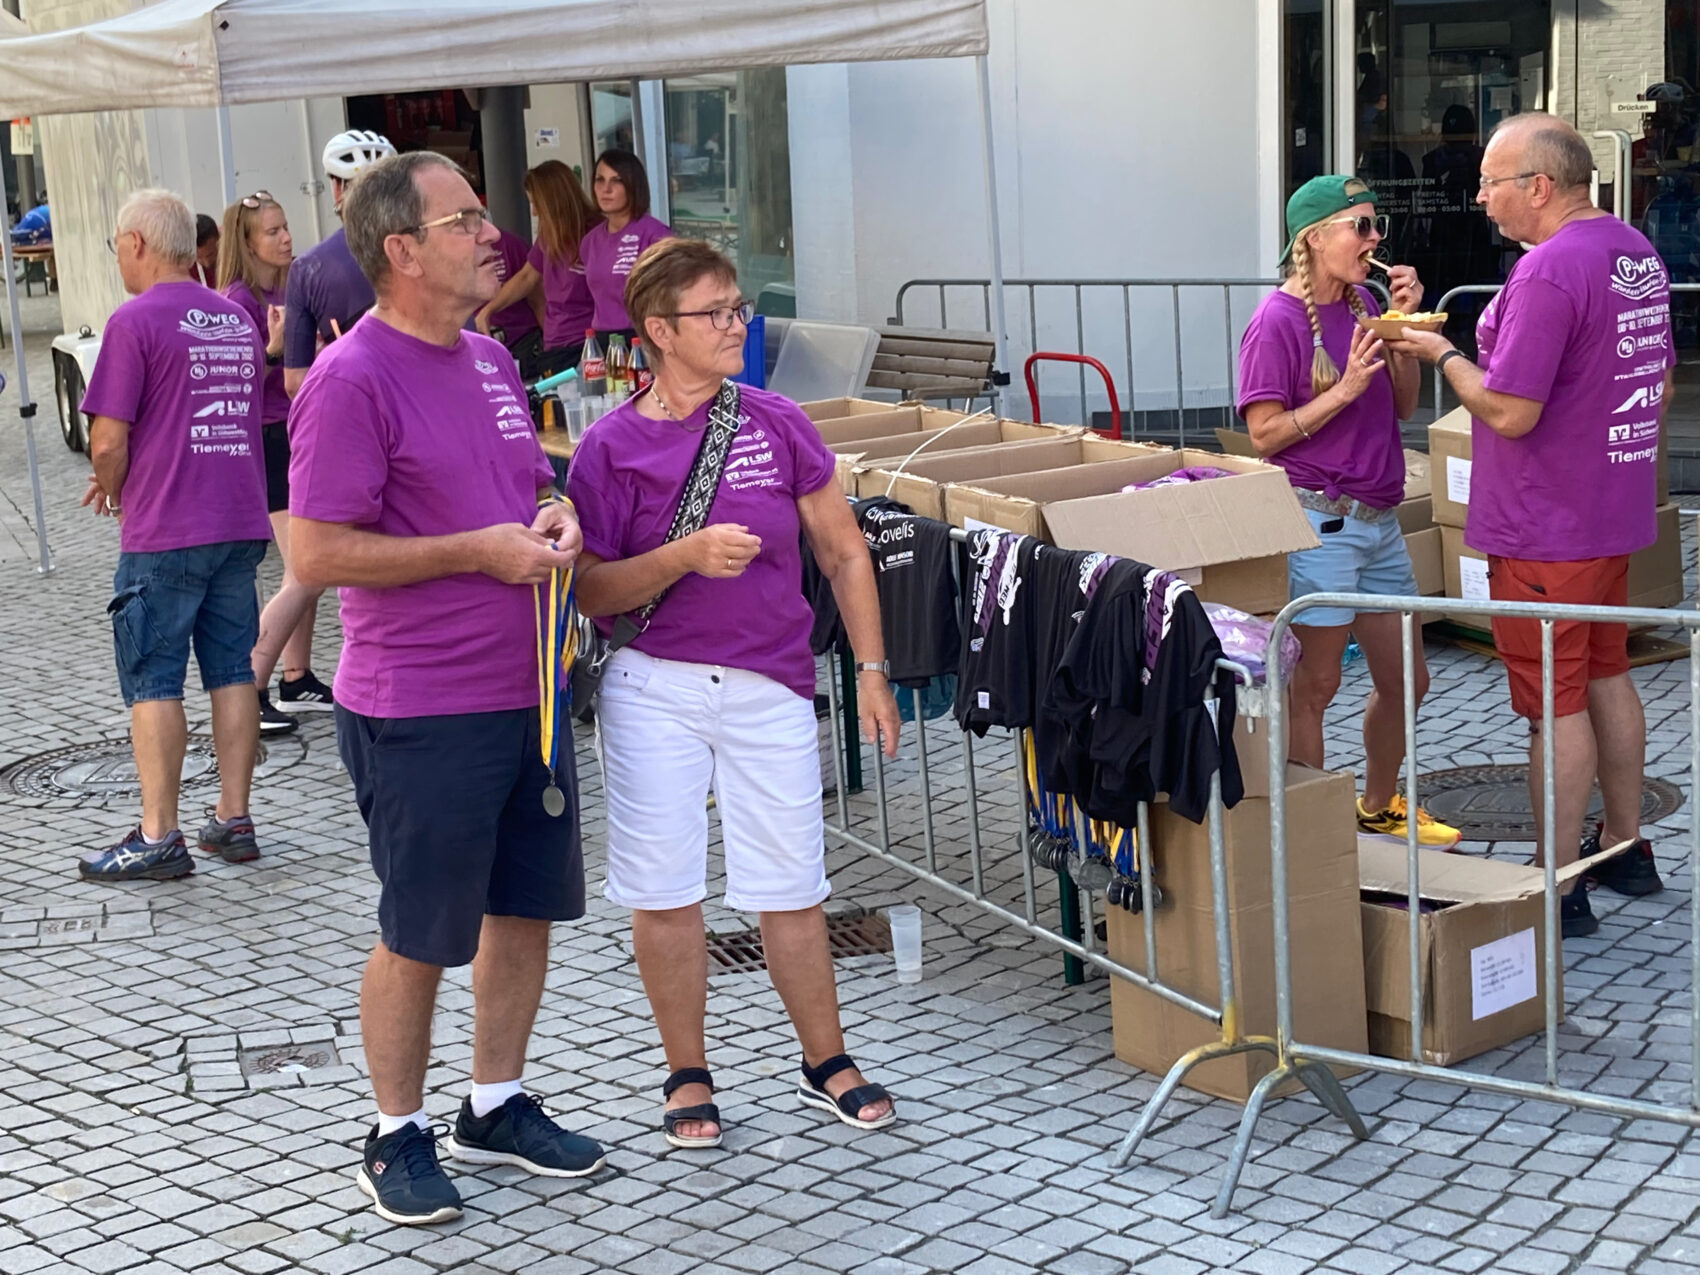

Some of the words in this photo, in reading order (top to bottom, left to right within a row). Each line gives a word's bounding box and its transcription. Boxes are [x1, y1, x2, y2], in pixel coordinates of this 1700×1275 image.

[1617, 103, 1649, 111] Drücken
[749, 451, 772, 463] LSW
[878, 521, 915, 544] ovelis
